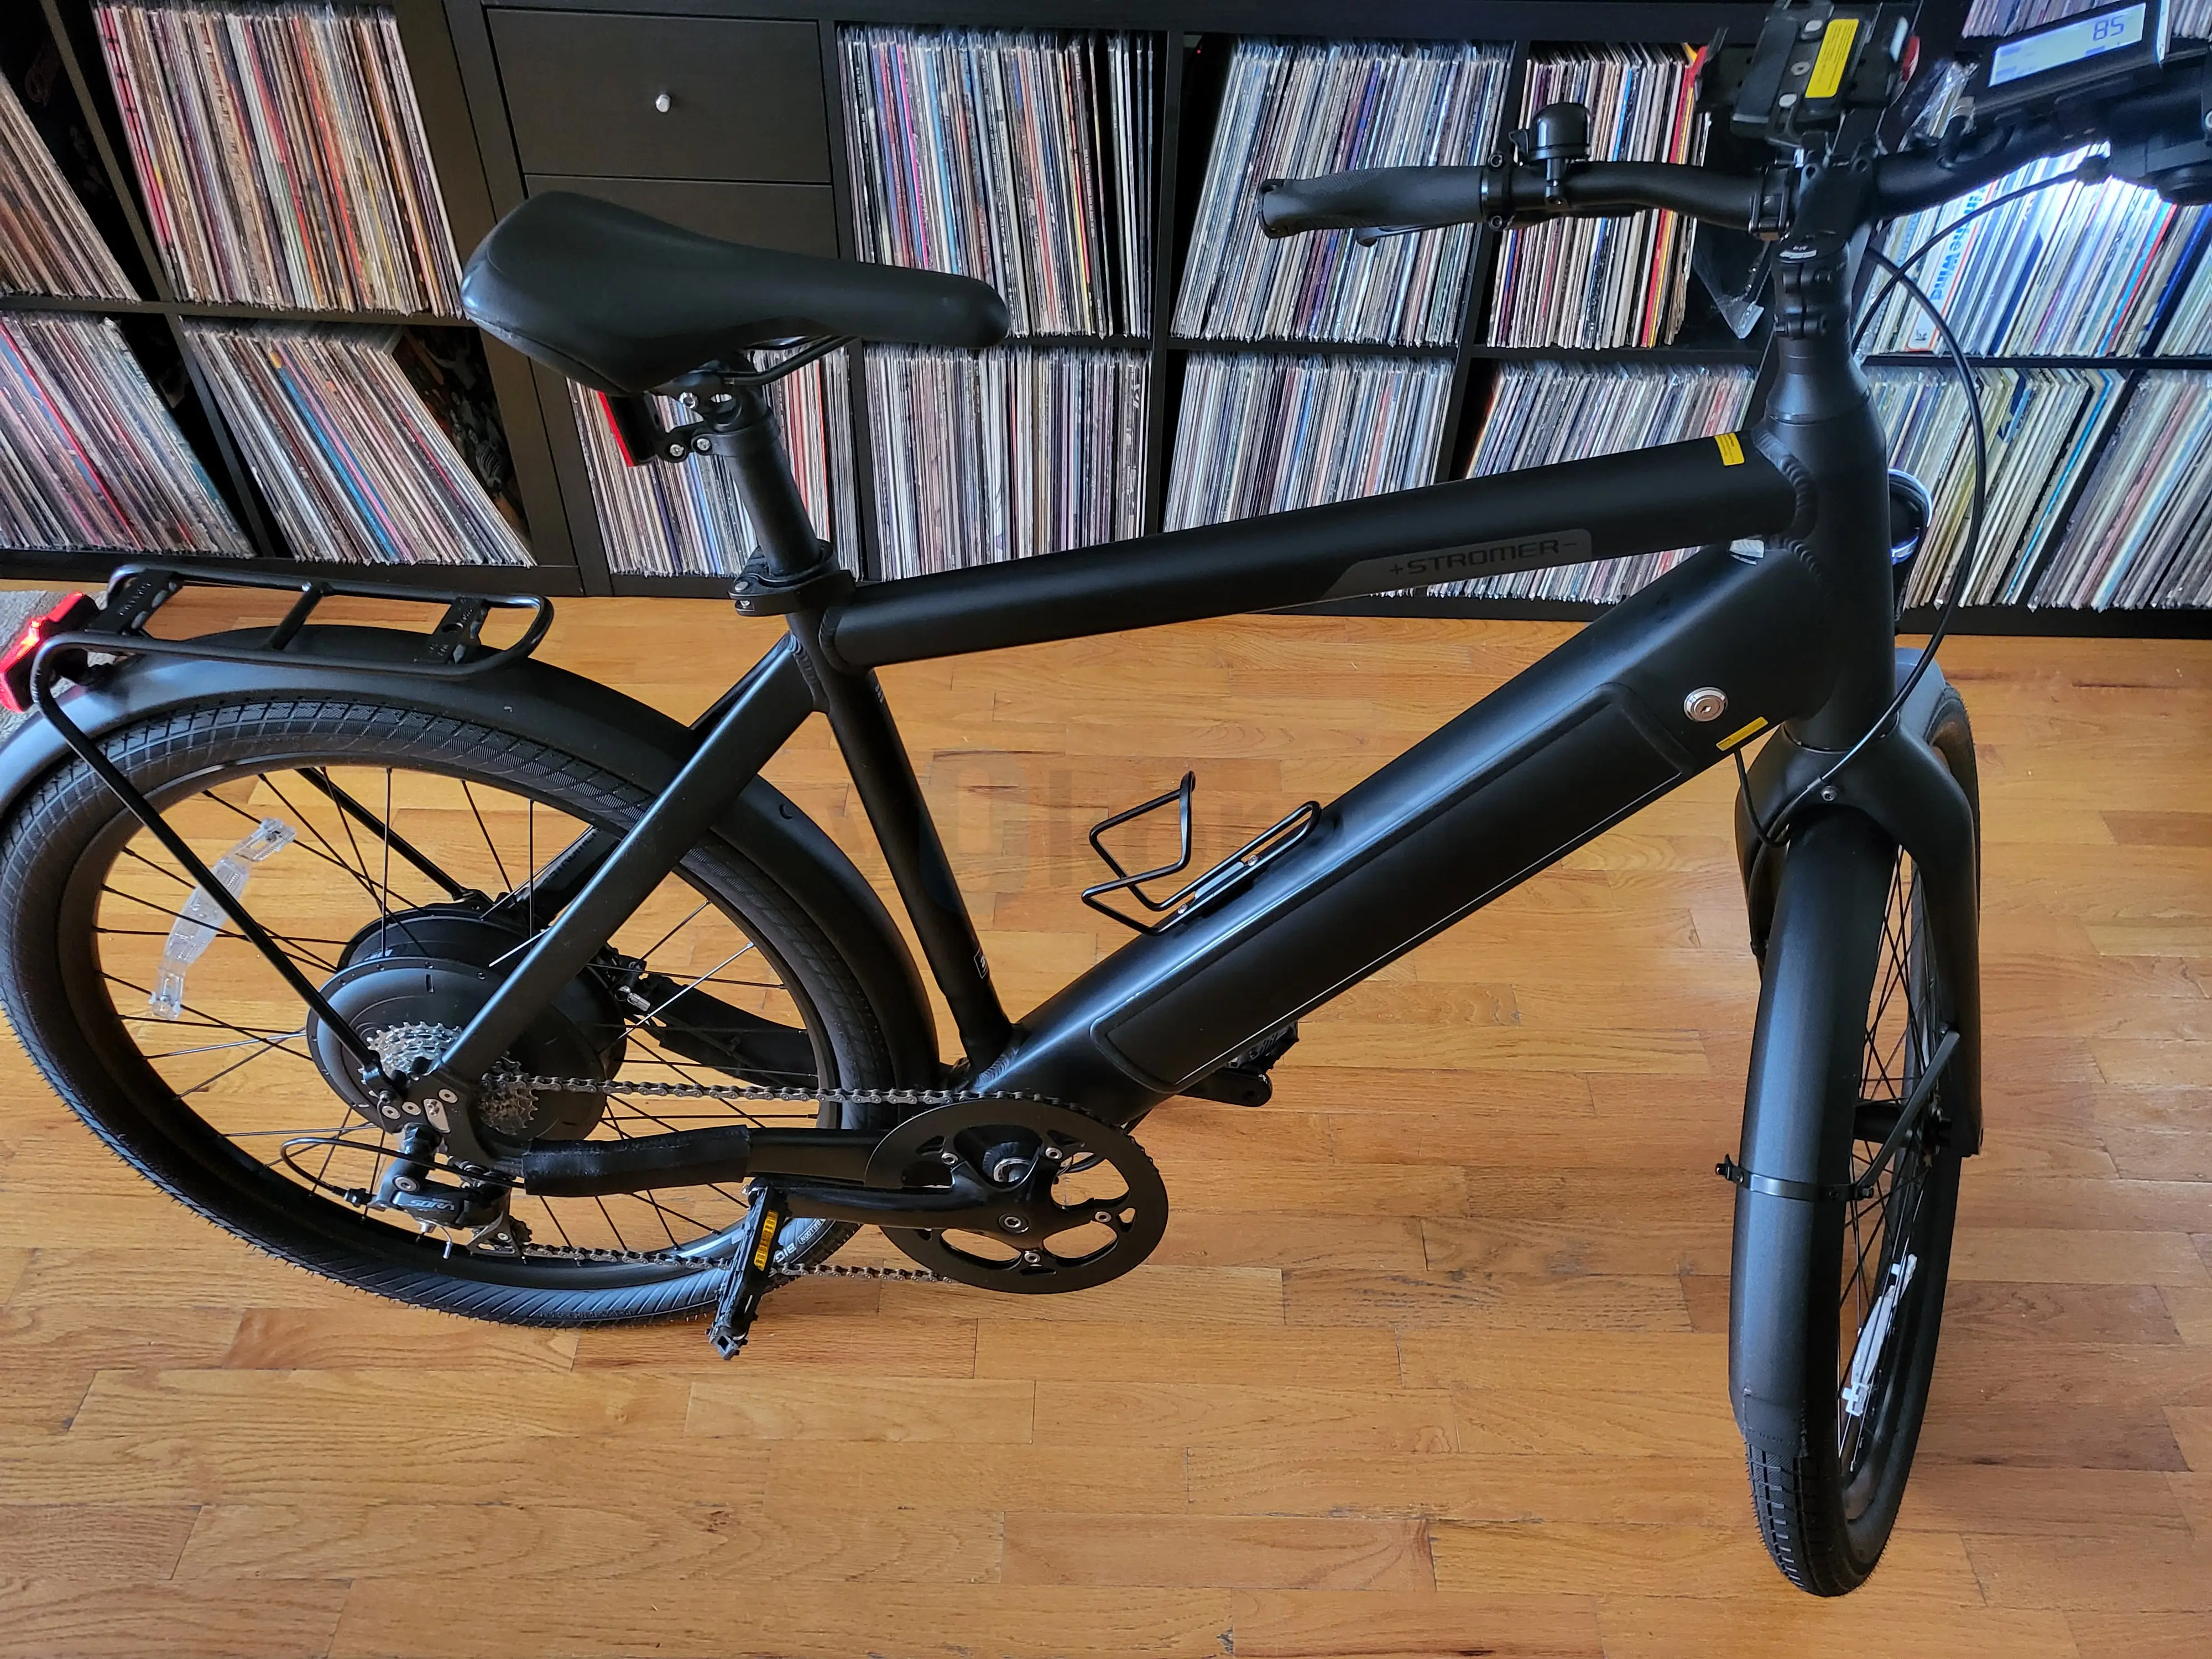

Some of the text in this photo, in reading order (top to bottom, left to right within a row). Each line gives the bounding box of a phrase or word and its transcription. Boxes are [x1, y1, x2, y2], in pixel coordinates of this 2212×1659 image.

[2093, 15, 2124, 41] 85
[775, 1219, 821, 1263] BALLOON BIG
